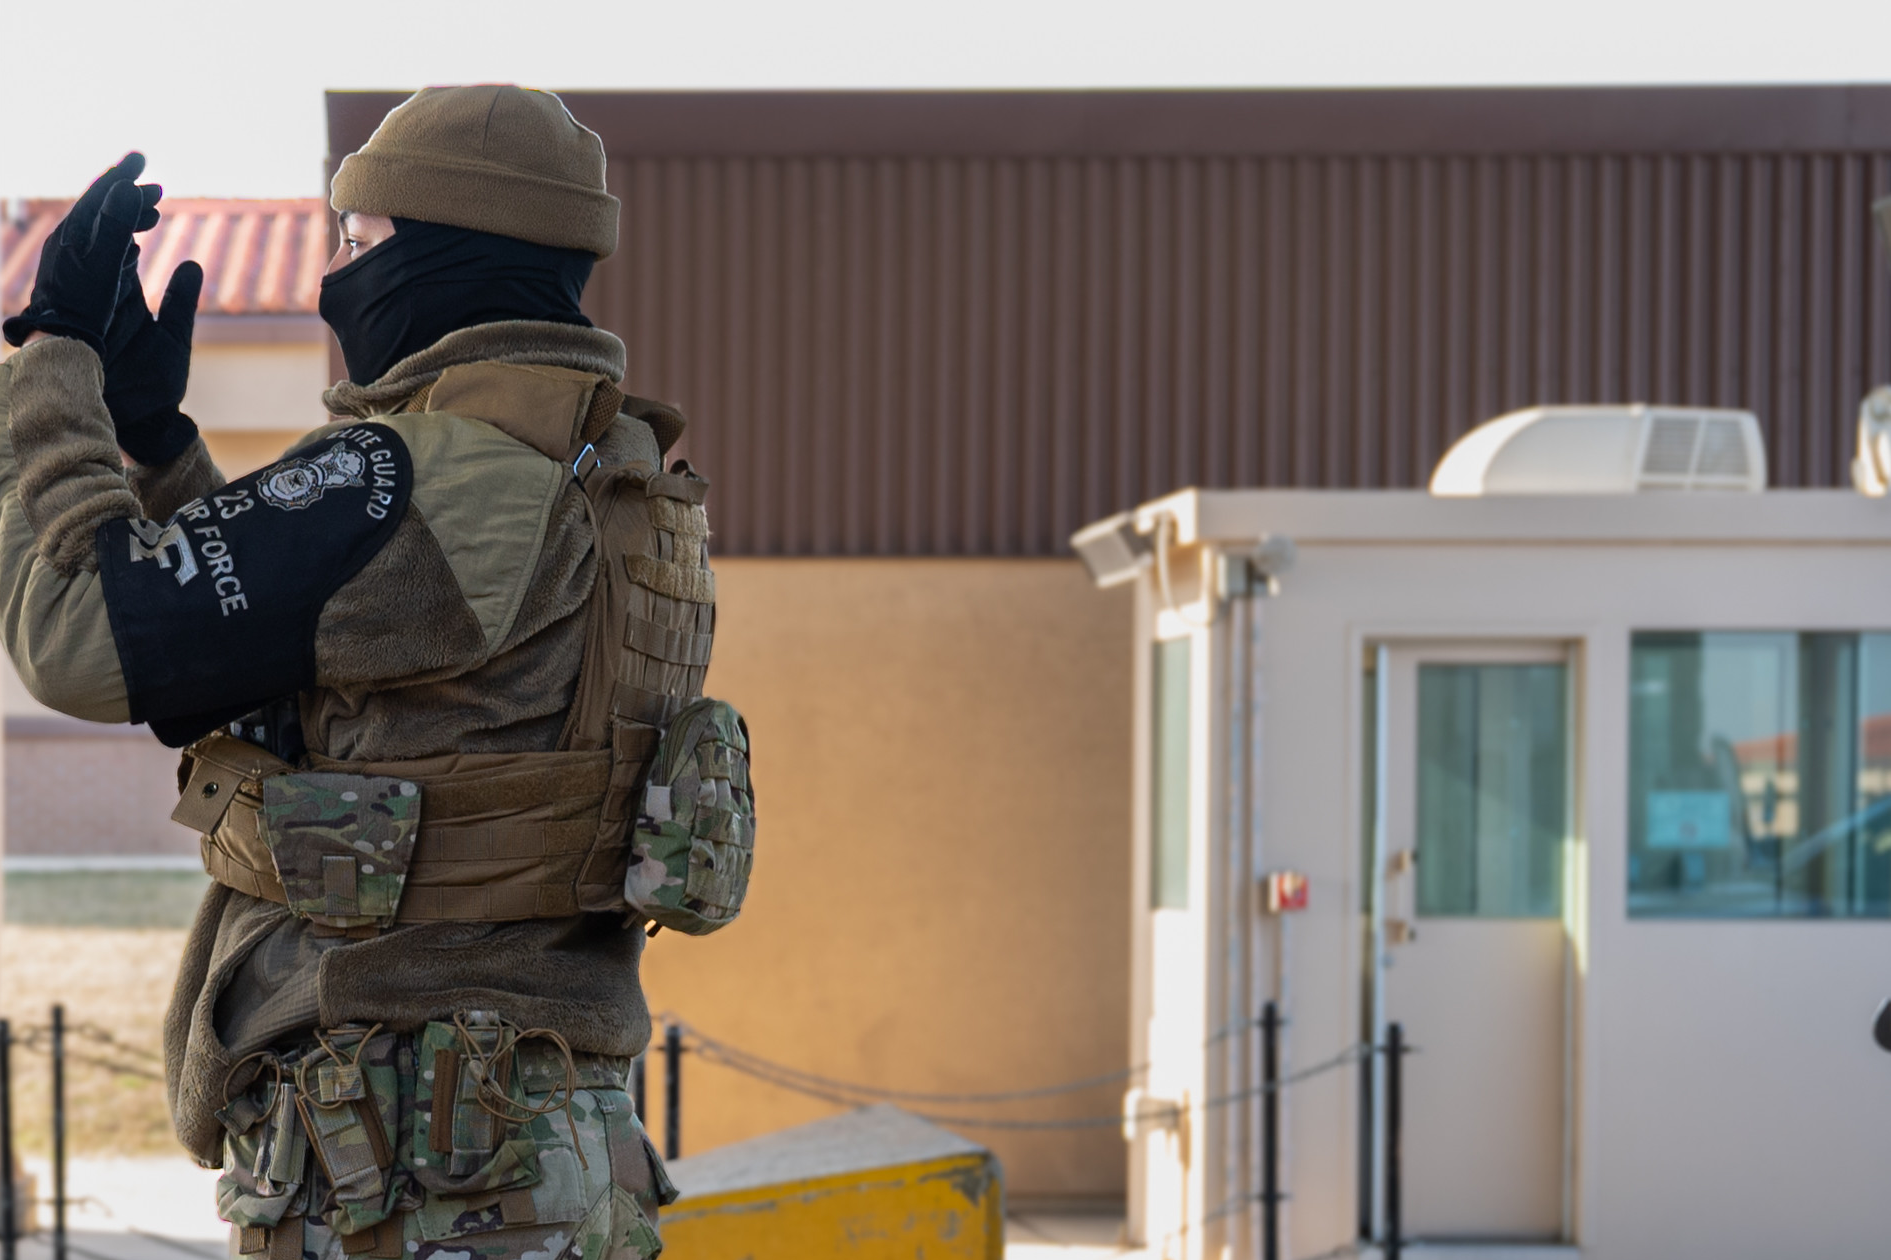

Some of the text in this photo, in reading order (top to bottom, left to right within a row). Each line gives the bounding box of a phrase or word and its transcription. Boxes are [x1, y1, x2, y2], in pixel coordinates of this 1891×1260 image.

[213, 489, 255, 520] 23
[366, 449, 396, 520] GUARD
[176, 498, 249, 617] IR FORCE
